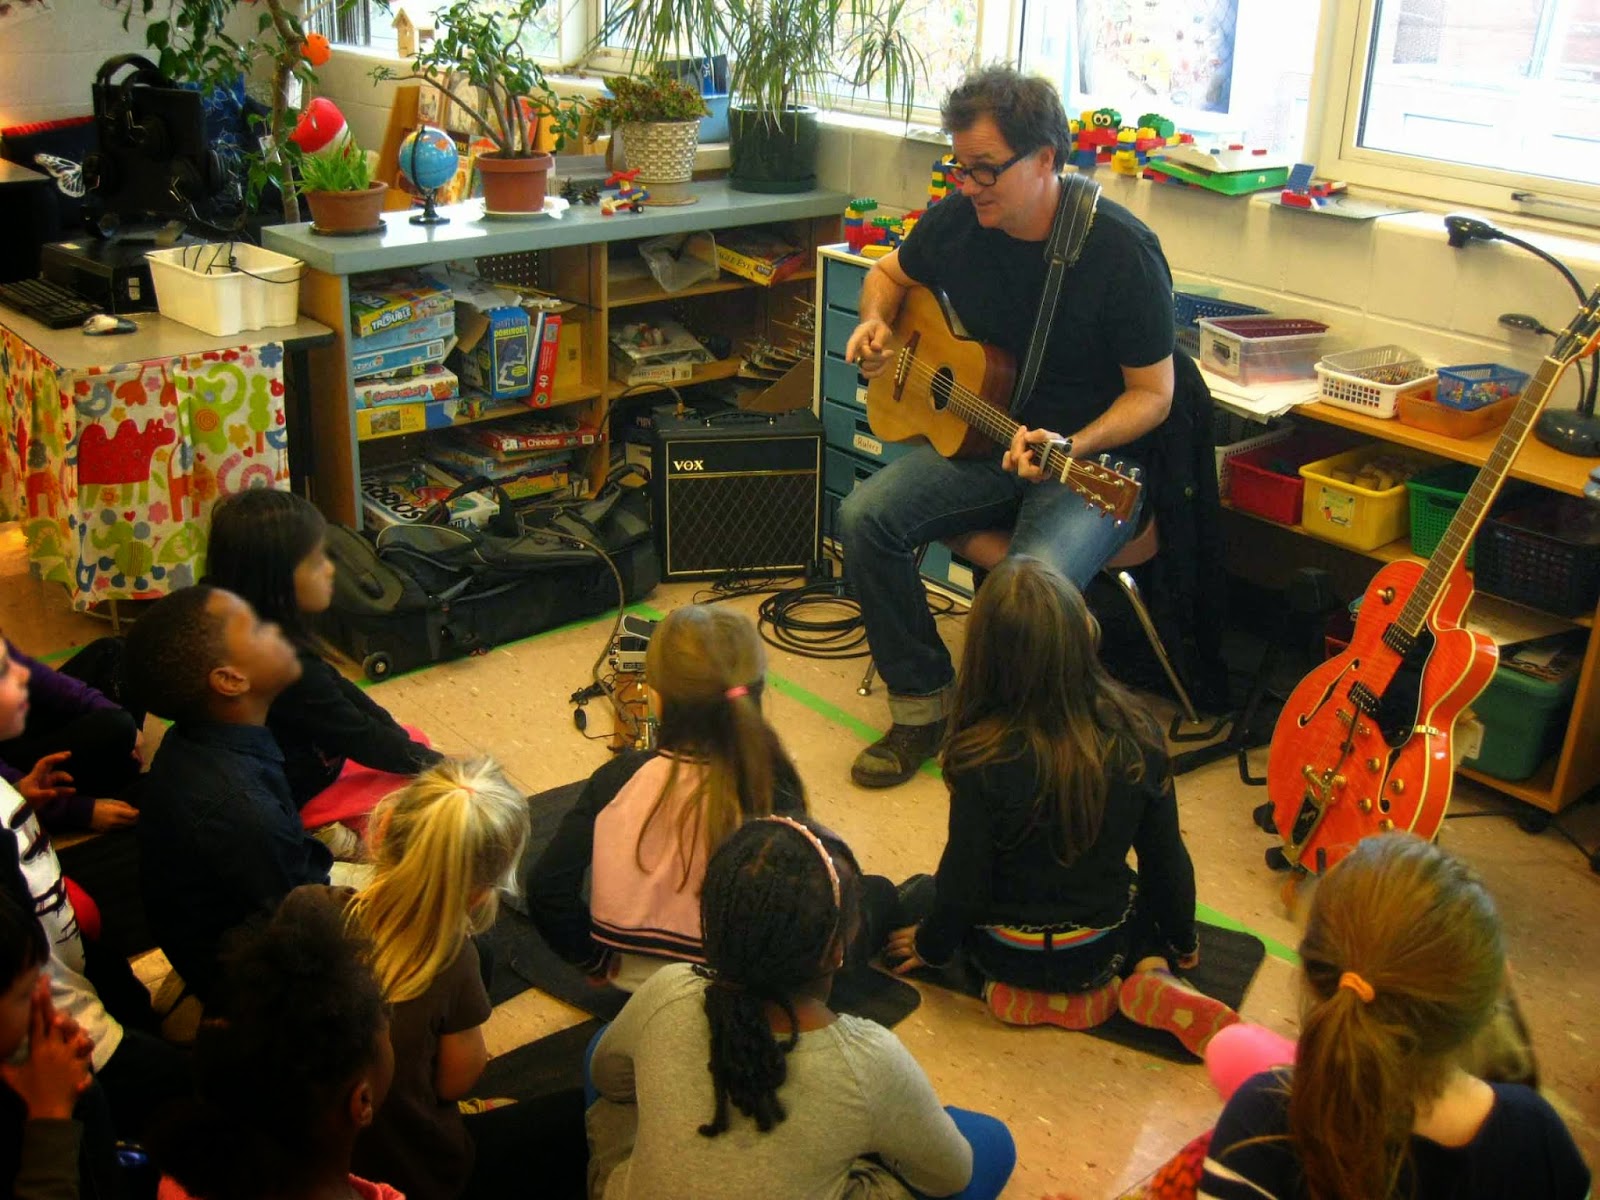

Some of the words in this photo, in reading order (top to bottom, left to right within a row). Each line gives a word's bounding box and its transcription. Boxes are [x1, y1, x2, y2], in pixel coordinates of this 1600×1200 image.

[371, 306, 412, 331] TROUBLE
[540, 375, 549, 388] 40
[673, 460, 704, 471] VOX
